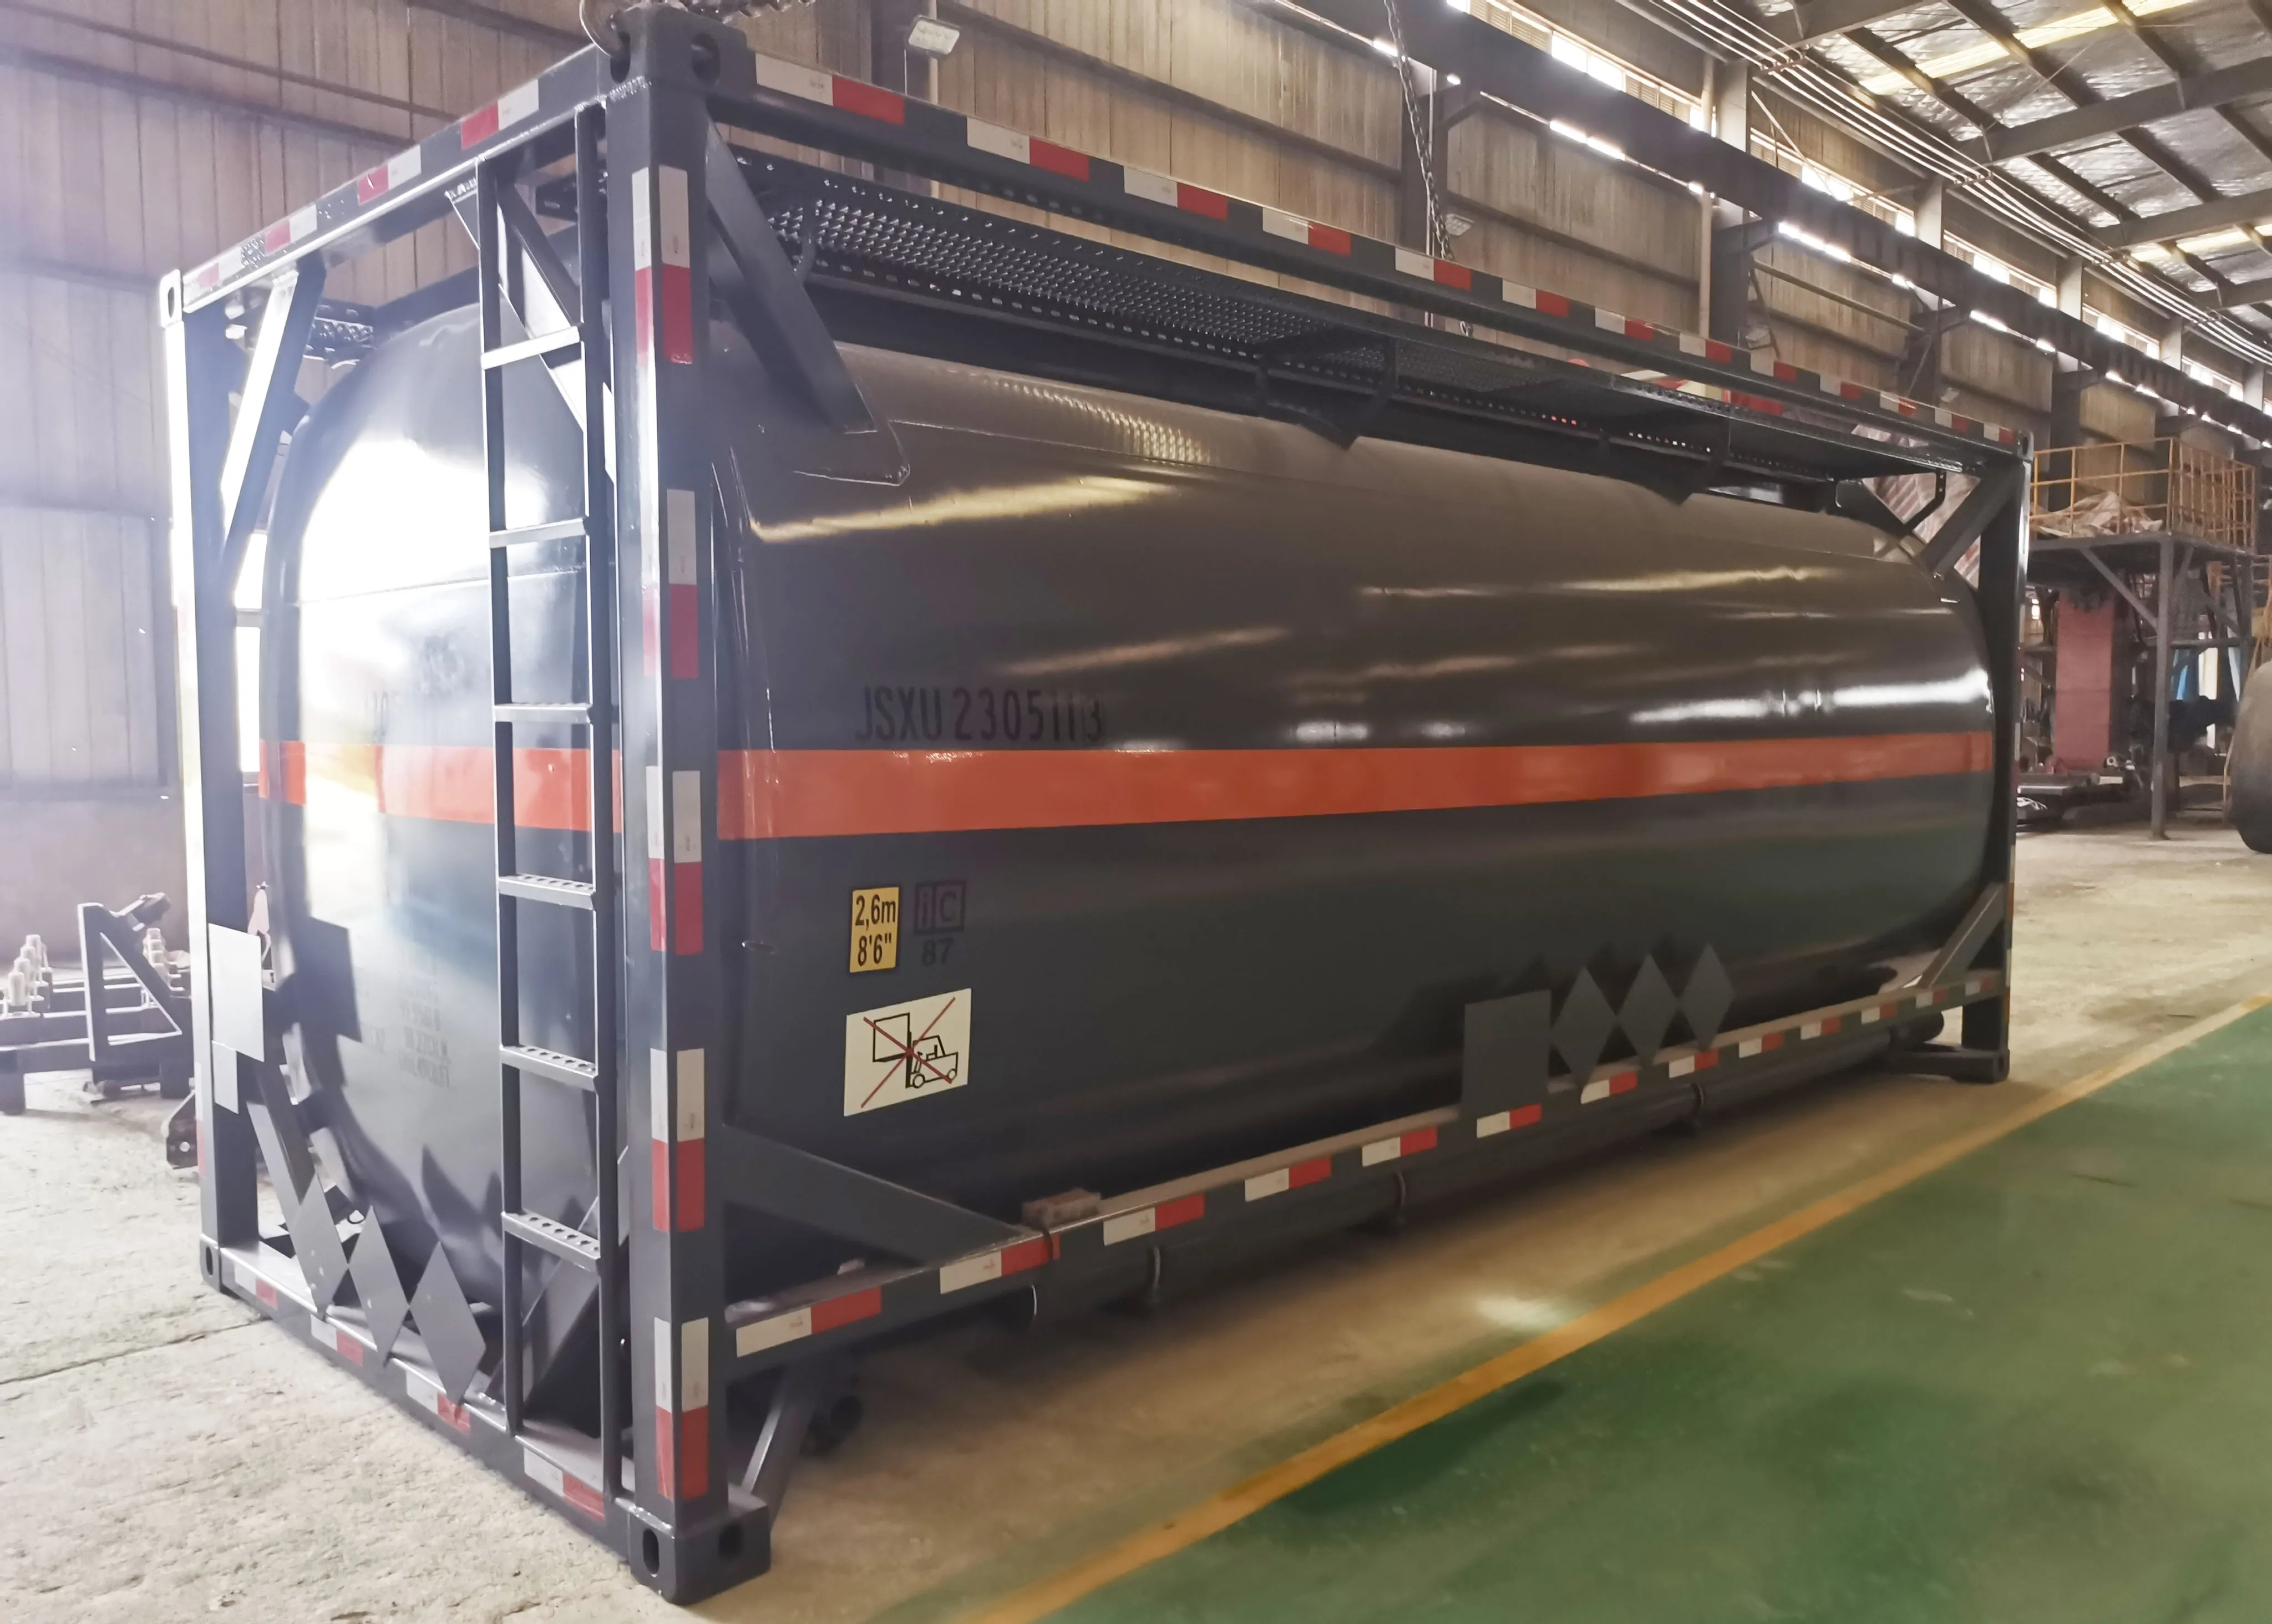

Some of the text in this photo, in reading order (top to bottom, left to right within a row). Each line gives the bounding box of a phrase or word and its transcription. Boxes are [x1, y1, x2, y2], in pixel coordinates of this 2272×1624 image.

[855, 685, 943, 742] JSXU
[855, 894, 896, 931] 2,6m
[921, 937, 954, 966] 87
